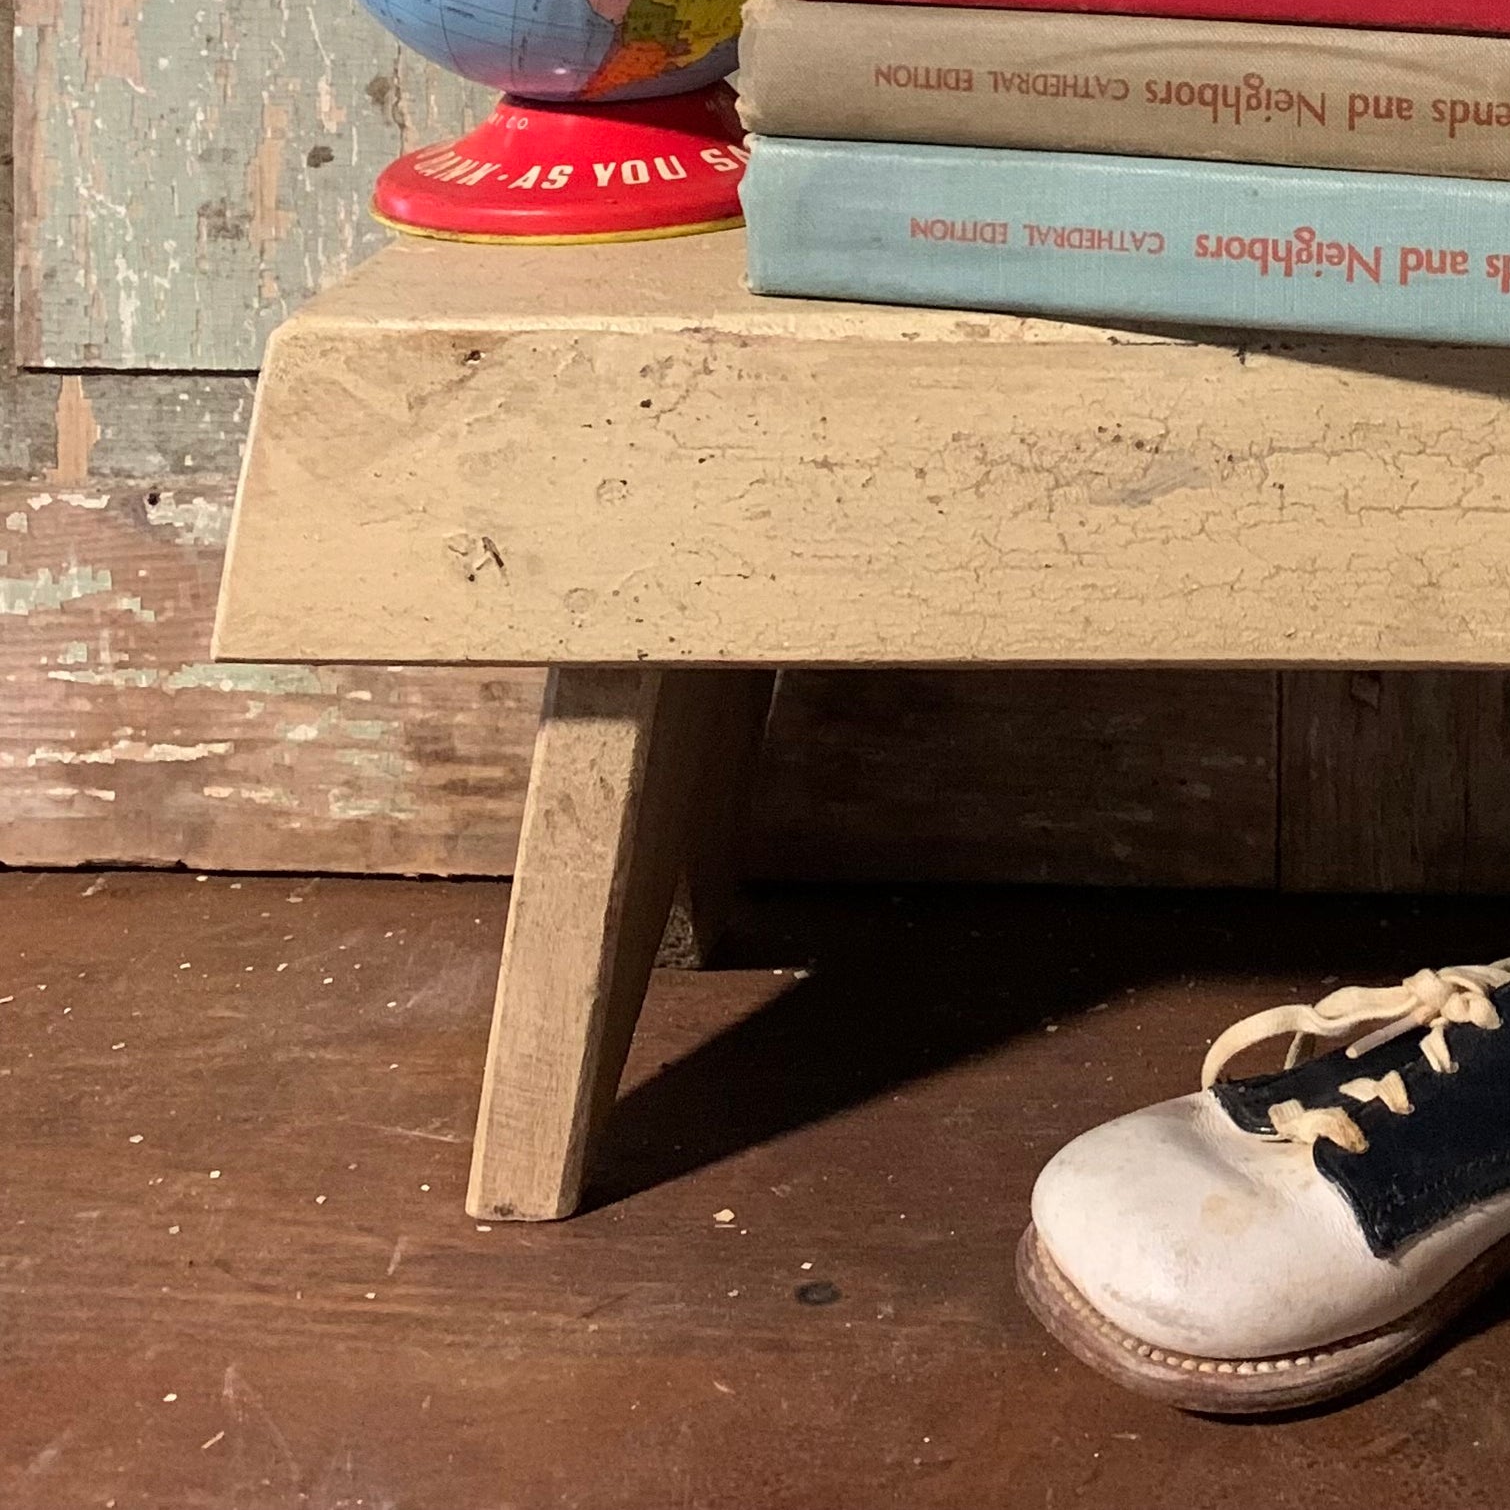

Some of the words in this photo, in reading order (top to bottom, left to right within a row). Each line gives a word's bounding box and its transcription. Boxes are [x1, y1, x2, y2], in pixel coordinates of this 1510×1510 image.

[874, 63, 975, 91] EDITION
[988, 69, 1130, 102] CATHEDRAL
[1145, 72, 1327, 126] Neighbors
[1348, 91, 1413, 131] and
[507, 165, 574, 190] AS
[592, 154, 688, 188] YOU
[909, 216, 1009, 245] EDITION
[1023, 222, 1165, 256] CATHEDRAL
[1194, 226, 1382, 285] Neighbors
[1400, 245, 1469, 286] and
